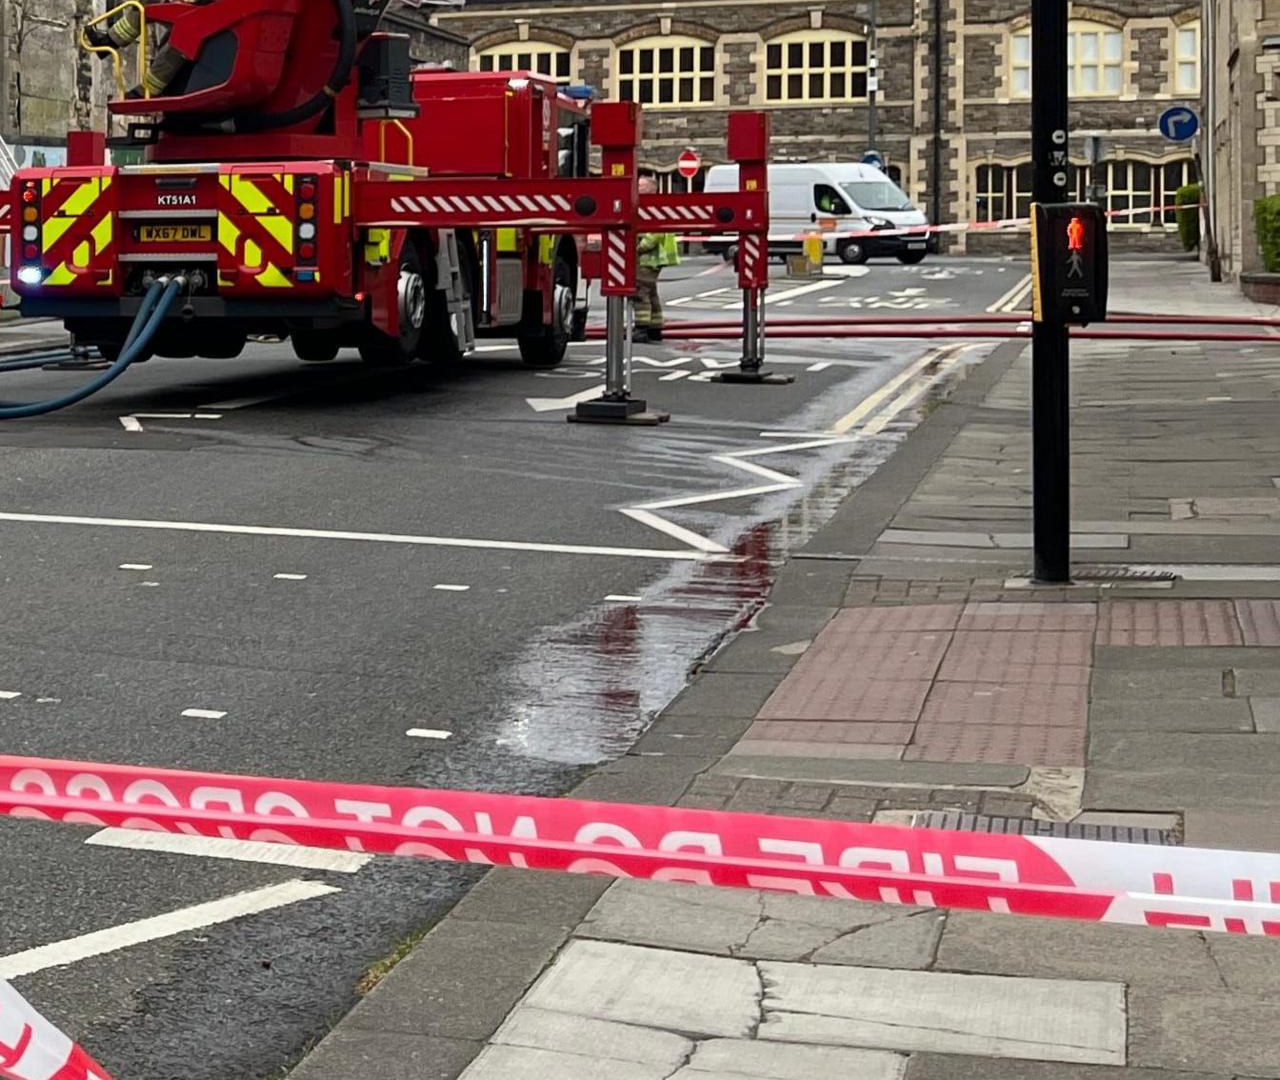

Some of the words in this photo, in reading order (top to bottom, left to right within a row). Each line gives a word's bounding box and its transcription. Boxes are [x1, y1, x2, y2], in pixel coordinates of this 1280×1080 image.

[157, 195, 197, 205] KT51A1
[145, 227, 179, 239] WX67
[181, 227, 206, 239] DWL
